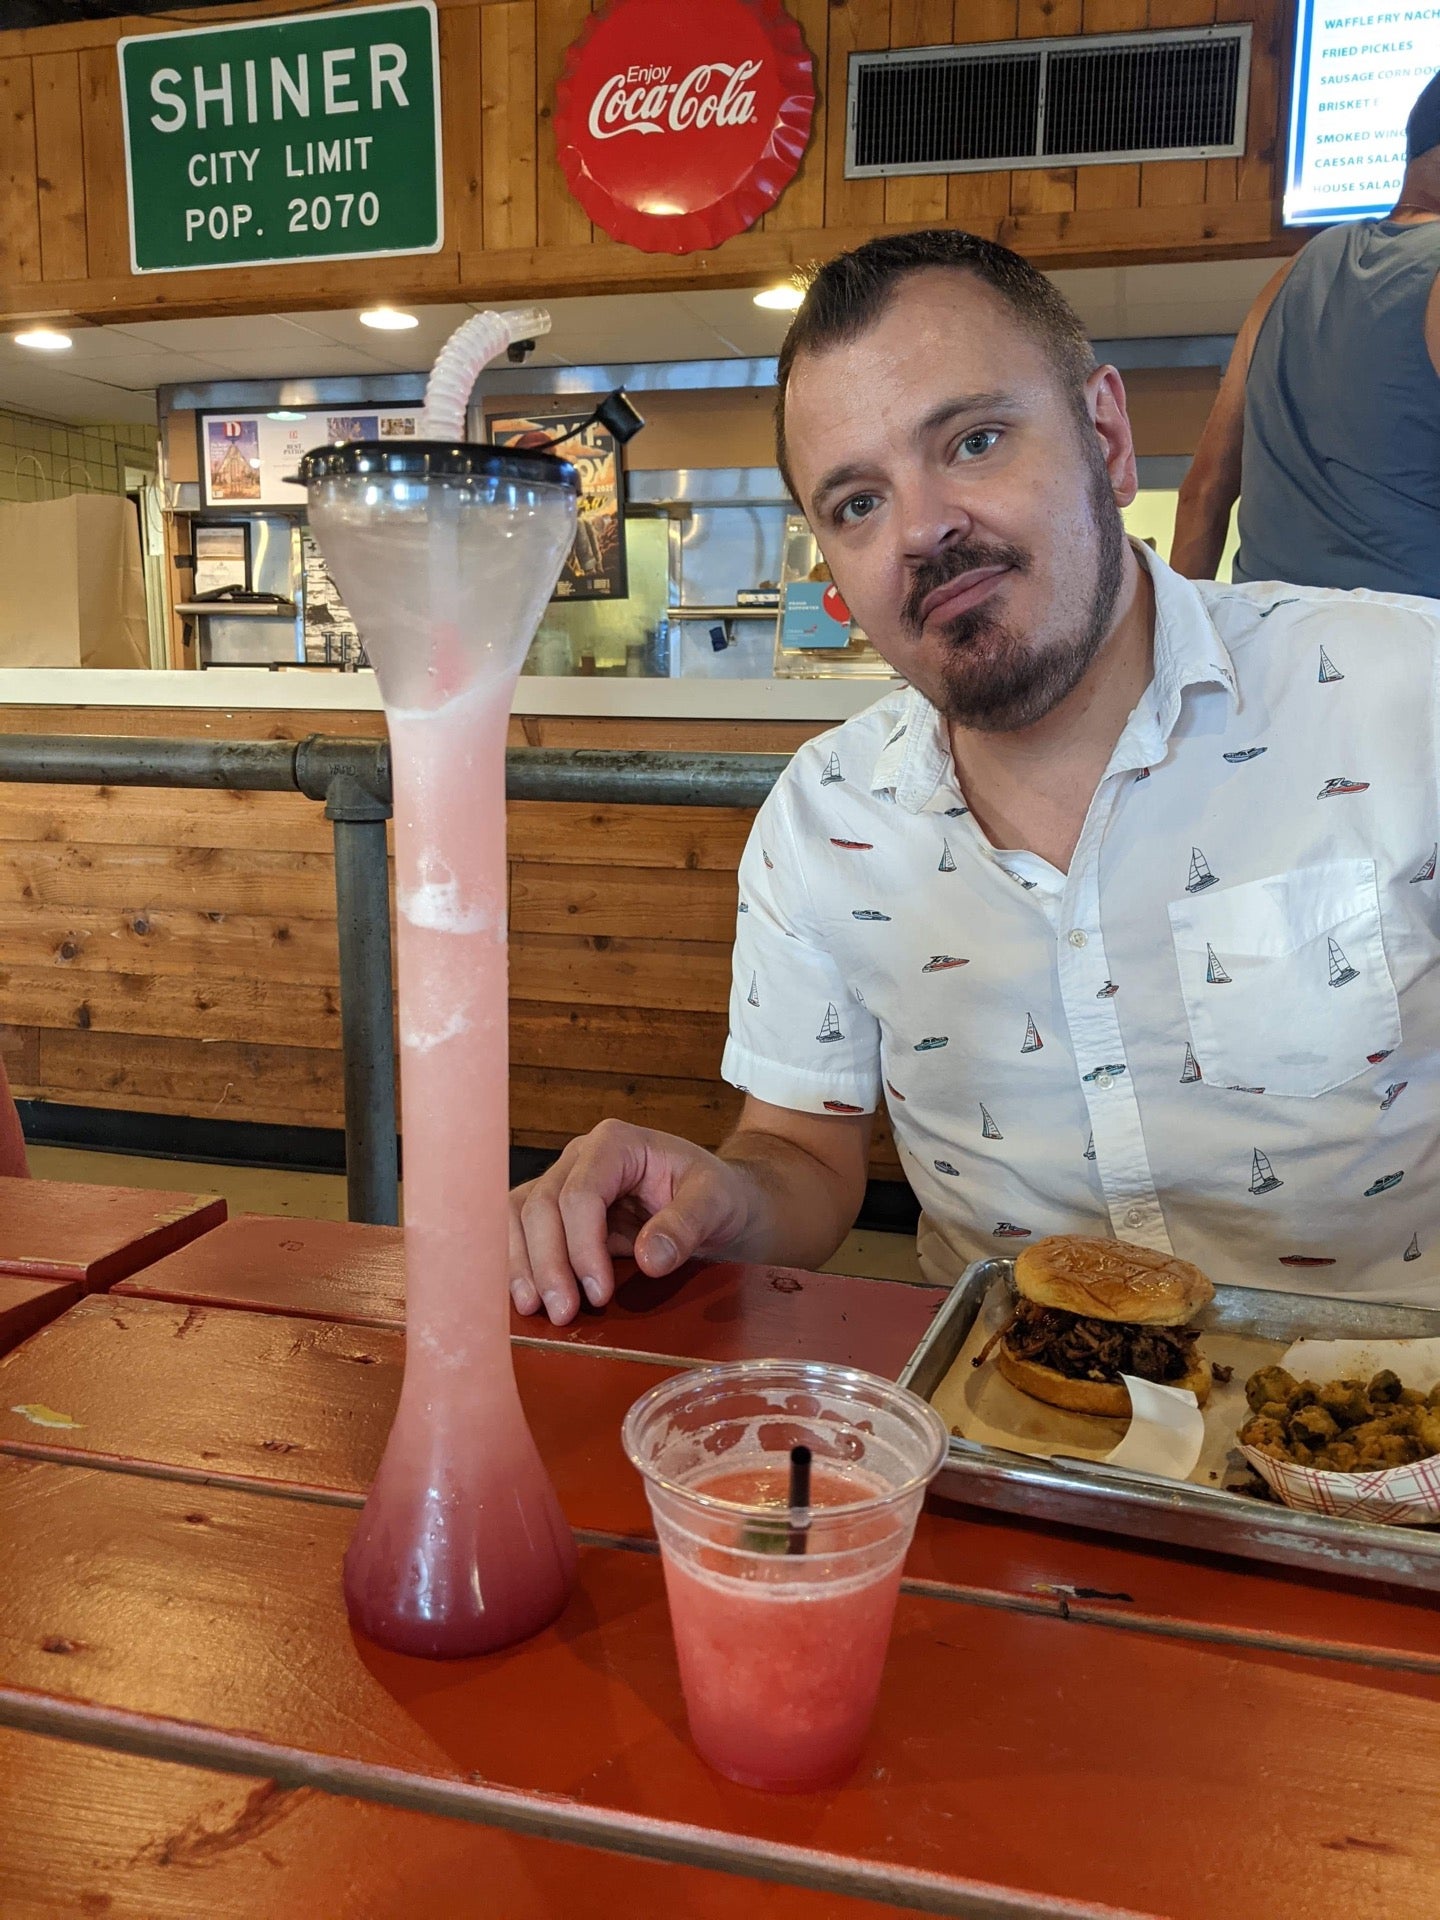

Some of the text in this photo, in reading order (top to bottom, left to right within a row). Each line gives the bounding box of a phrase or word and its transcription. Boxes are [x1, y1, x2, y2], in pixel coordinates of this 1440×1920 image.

[1324, 15, 1374, 30] WAFFLE
[1377, 12, 1401, 24] FRY
[1322, 40, 1414, 59] FRIED PICKLES
[627, 65, 672, 85] Enjoy
[1320, 71, 1374, 86] SAUSAGE
[1377, 68, 1411, 81] CORN
[150, 42, 410, 133] SHINER
[588, 59, 763, 140] Coca-Cola
[1318, 98, 1370, 113] BRISKET
[1316, 131, 1370, 144] SMOKED
[187, 135, 374, 188] CITY LIMIT
[1314, 155, 1364, 168] CAESAR
[1313, 178, 1401, 194] HOUSE SALAD
[185, 191, 380, 242] POP. 2070
